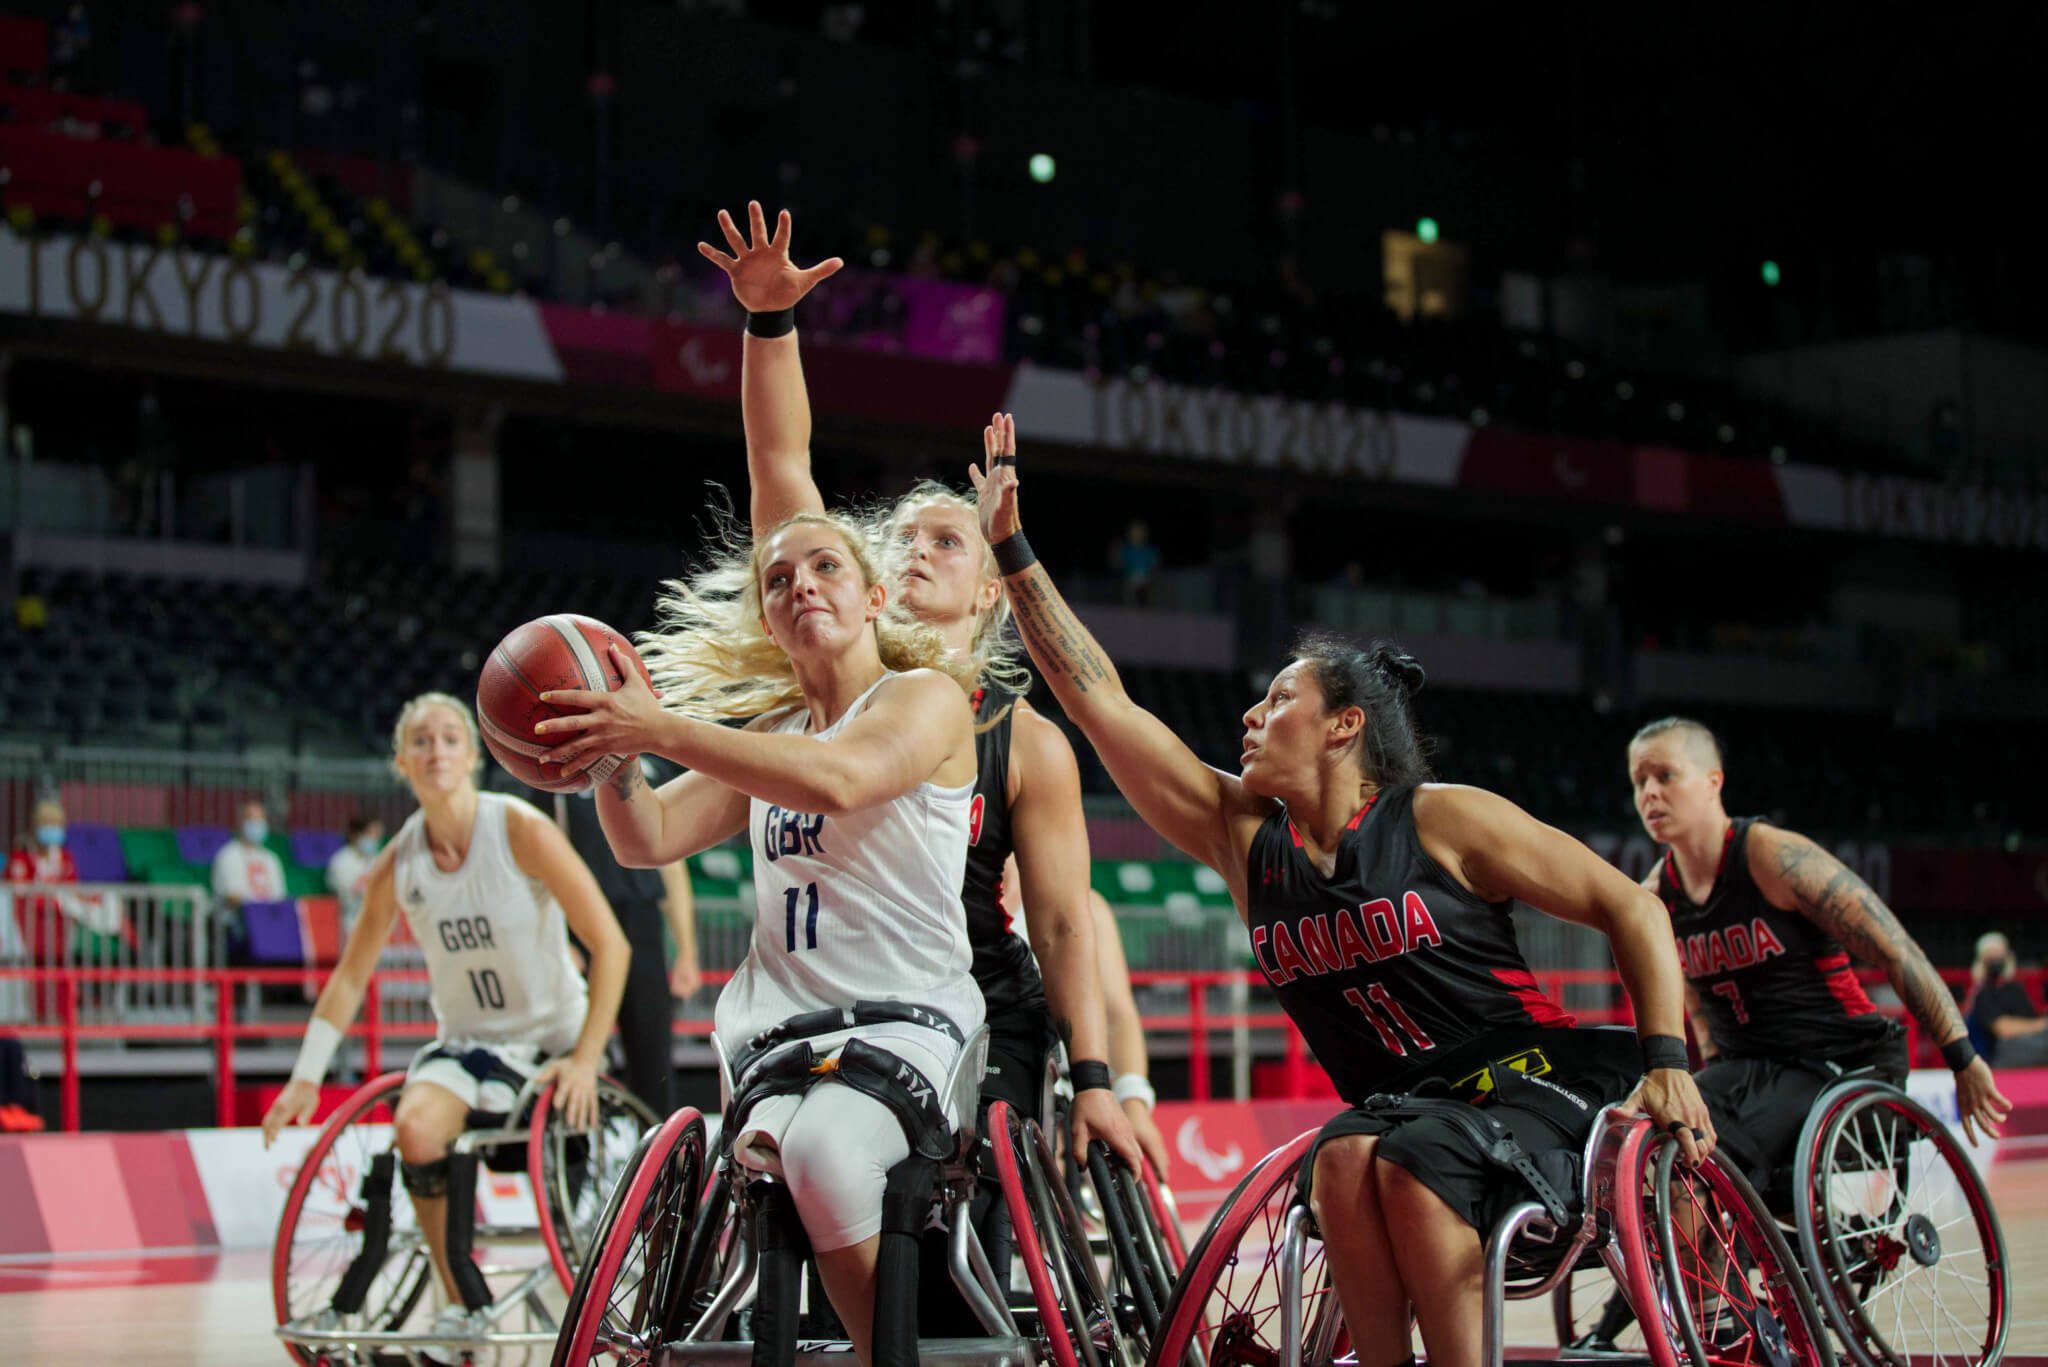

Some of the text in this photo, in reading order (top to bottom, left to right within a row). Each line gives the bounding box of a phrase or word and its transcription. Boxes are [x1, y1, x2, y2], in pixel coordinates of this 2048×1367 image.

[16, 232, 454, 369] TOKYO 2020
[1087, 374, 1399, 479] TOKYO 2020
[764, 804, 827, 862] GBR
[438, 915, 496, 953] GBR
[783, 881, 820, 953] 11
[1253, 891, 1443, 987] CANADA
[1675, 917, 1786, 979] ANADA
[467, 968, 506, 1011] 10
[1342, 981, 1437, 1057] 11
[1712, 980, 1750, 1024] 7
[895, 1062, 933, 1110] FIX
